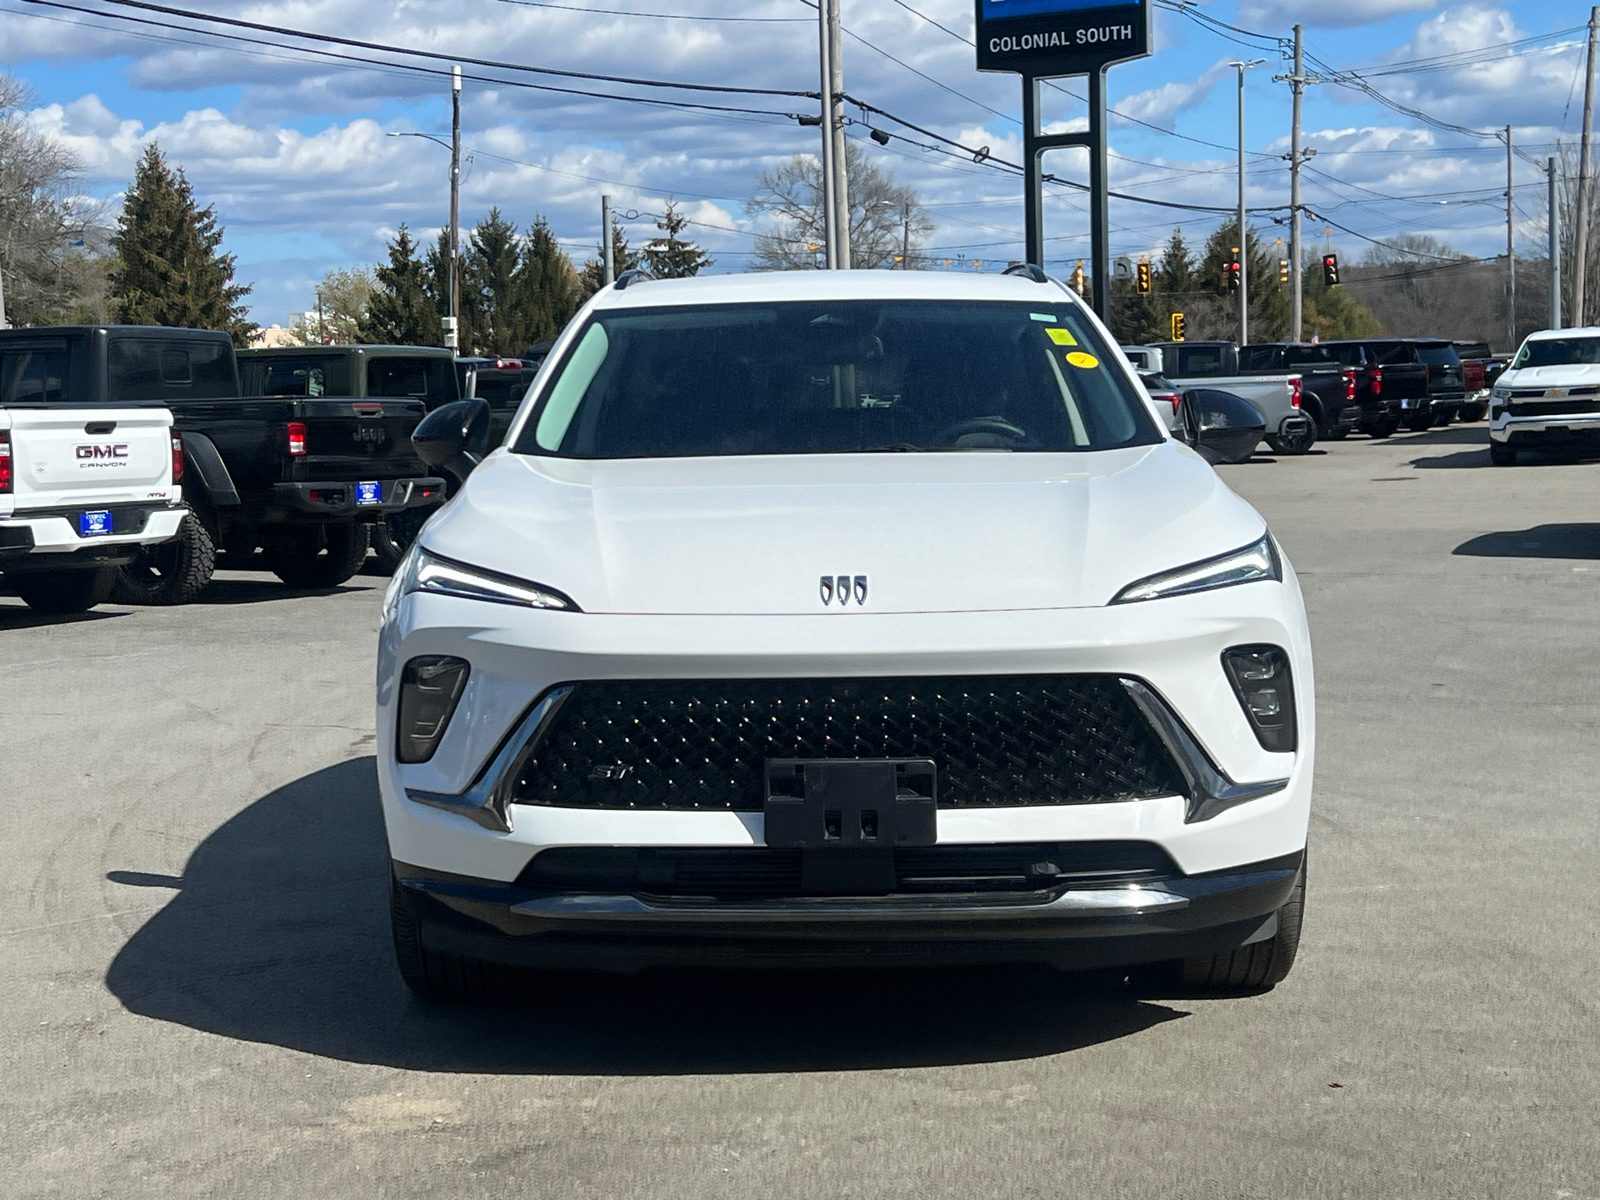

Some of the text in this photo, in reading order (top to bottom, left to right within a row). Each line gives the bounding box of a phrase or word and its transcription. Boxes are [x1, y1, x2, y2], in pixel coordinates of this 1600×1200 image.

[989, 24, 1132, 53] COLONIAL SOUTH
[352, 423, 385, 445] Jeep
[75, 444, 128, 459] GMC
[80, 461, 127, 469] CANYON
